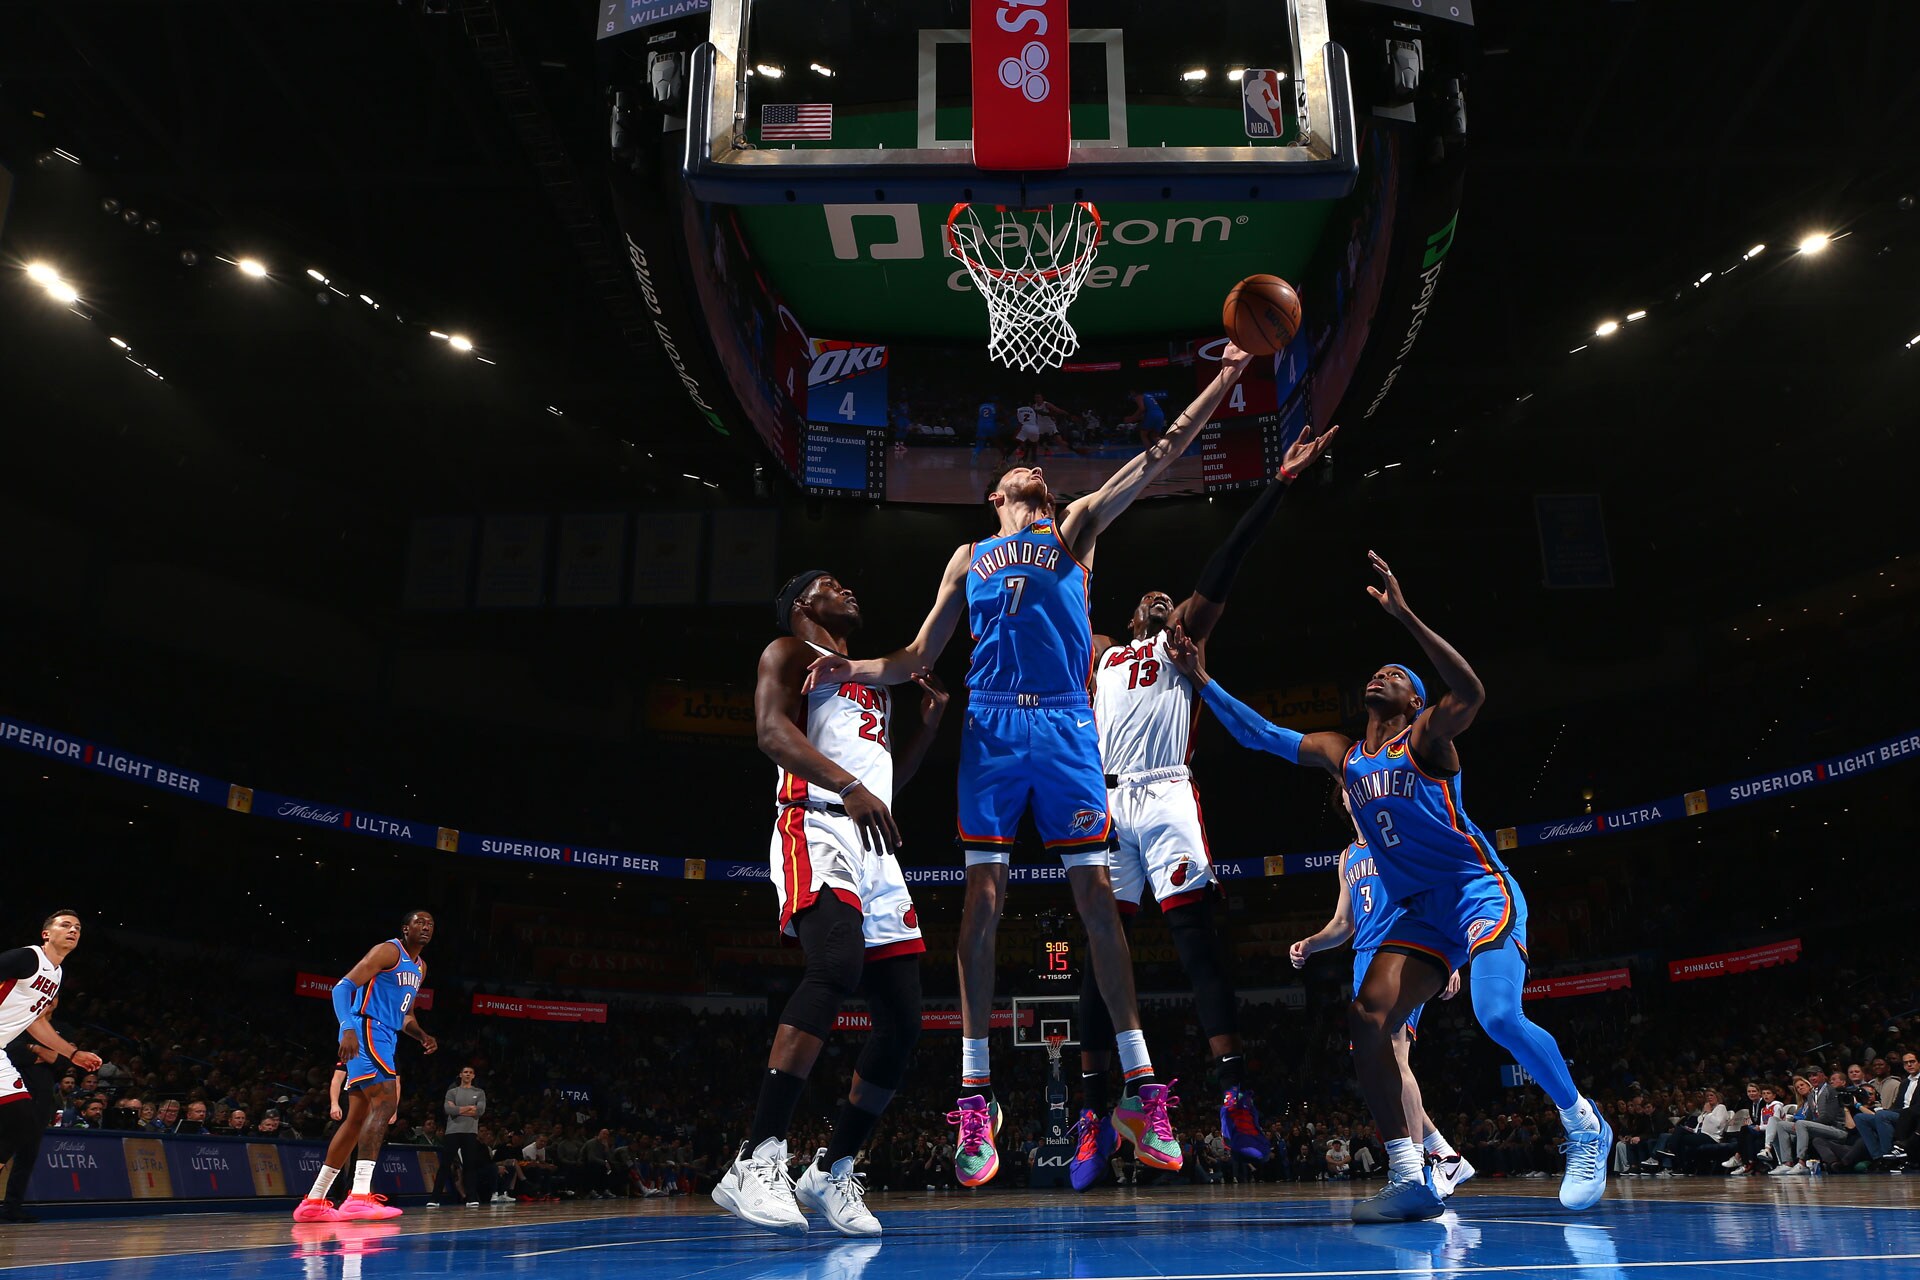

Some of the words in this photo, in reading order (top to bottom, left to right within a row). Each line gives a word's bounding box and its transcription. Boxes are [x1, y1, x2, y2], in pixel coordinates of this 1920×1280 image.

[606, 22, 615, 32] 8
[631, 1, 708, 25] WILLIAMS
[608, 4, 617, 15] 7
[1251, 122, 1269, 134] NBA
[946, 264, 1150, 292] ceer
[808, 346, 886, 387] OKC
[838, 392, 856, 421] 4
[1229, 383, 1247, 412] 4
[808, 424, 829, 432] PLAYER
[866, 429, 877, 437] PTS
[971, 540, 1061, 582] THUNDER
[1005, 574, 1028, 617] 7
[1127, 659, 1161, 691] 13
[1018, 694, 1039, 706] OKC
[97, 750, 153, 779] LIGHT
[156, 768, 201, 794] BEER
[1729, 769, 1814, 800] SUPERIOR
[1828, 750, 1876, 777] LIGHT
[1879, 735, 1920, 761] BEER
[1350, 769, 1416, 810] THUNDER
[277, 802, 340, 824] Michelob
[355, 815, 412, 839] ULTRA
[1375, 810, 1402, 849] 2
[1539, 820, 1593, 840] Michelob
[1607, 807, 1662, 828] ULTRA
[481, 840, 561, 860] SUPERIOR
[573, 850, 618, 866] LIGHT
[622, 857, 660, 872] BEER
[726, 865, 771, 878] Michelo
[904, 869, 967, 882] SUPERIO
[1031, 868, 1067, 879] BEER
[1360, 885, 1373, 914] 3
[1046, 941, 1069, 952] 9:06
[1049, 952, 1068, 971] 15
[1684, 960, 1724, 973] PINNACLE
[400, 992, 411, 1012] 8
[487, 1001, 523, 1012] PINNACLE
[1046, 1137, 1069, 1145] Health
[47, 1153, 98, 1169] ULTRA
[131, 1157, 164, 1172] ULTRA
[191, 1156, 229, 1171] ULTRA
[382, 1162, 408, 1173] ULTRA
